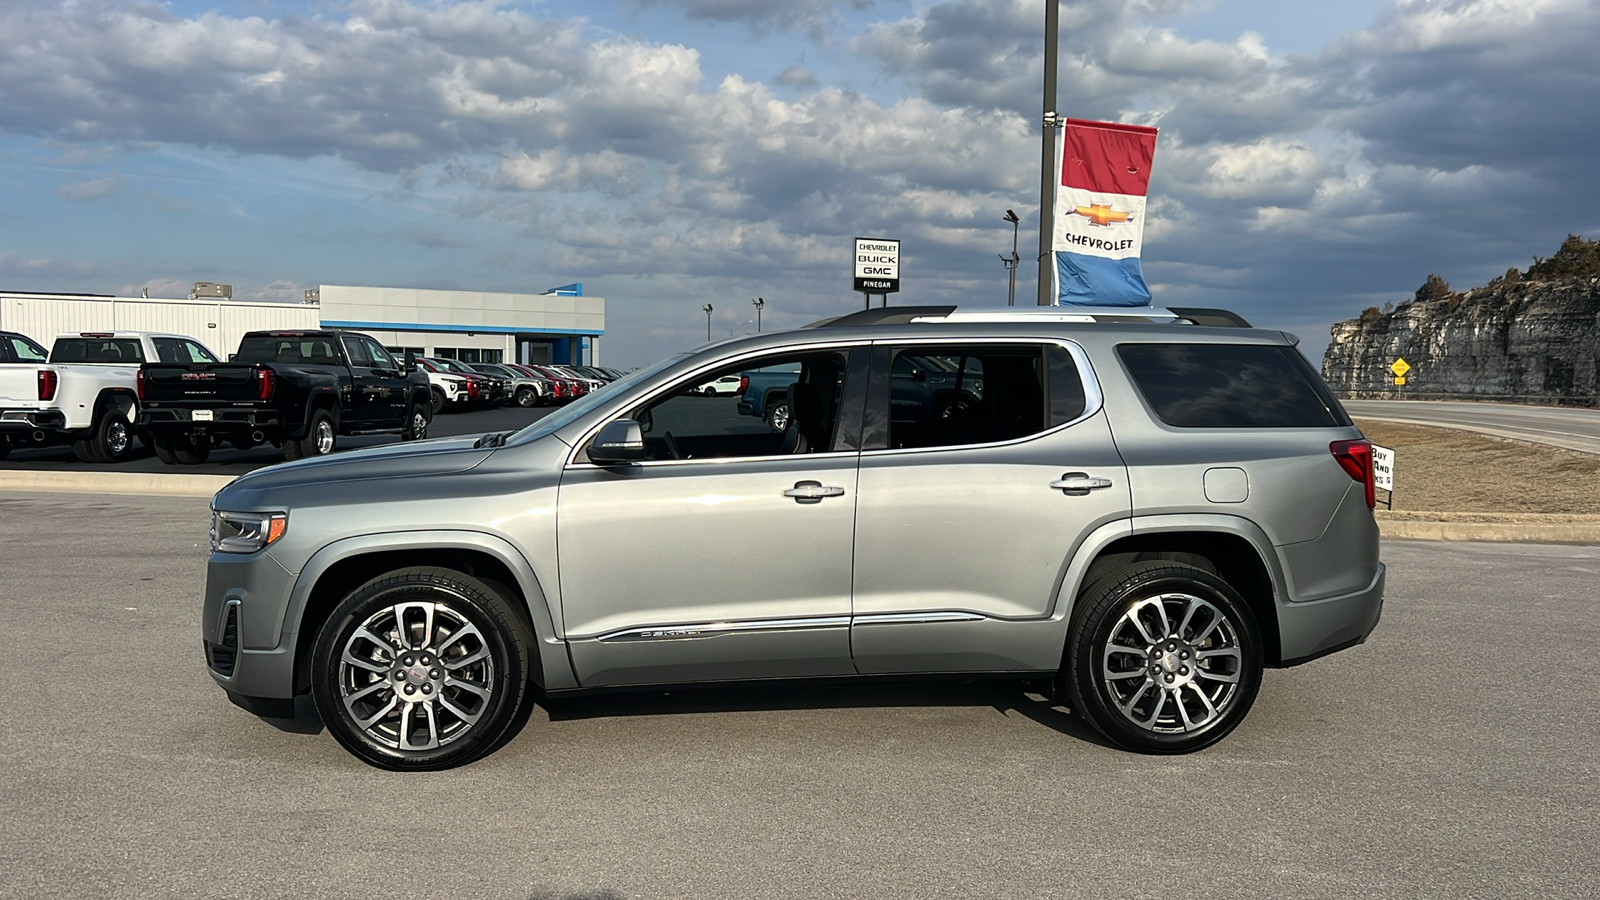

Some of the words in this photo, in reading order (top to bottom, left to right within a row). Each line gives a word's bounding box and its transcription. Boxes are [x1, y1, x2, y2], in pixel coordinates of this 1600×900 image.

[1065, 232, 1134, 251] CHEVROLET
[859, 243, 897, 252] CHEVROLET
[858, 255, 896, 264] BUICK
[863, 266, 892, 275] GMC
[863, 280, 891, 289] PINEGAR
[181, 372, 216, 380] GMC
